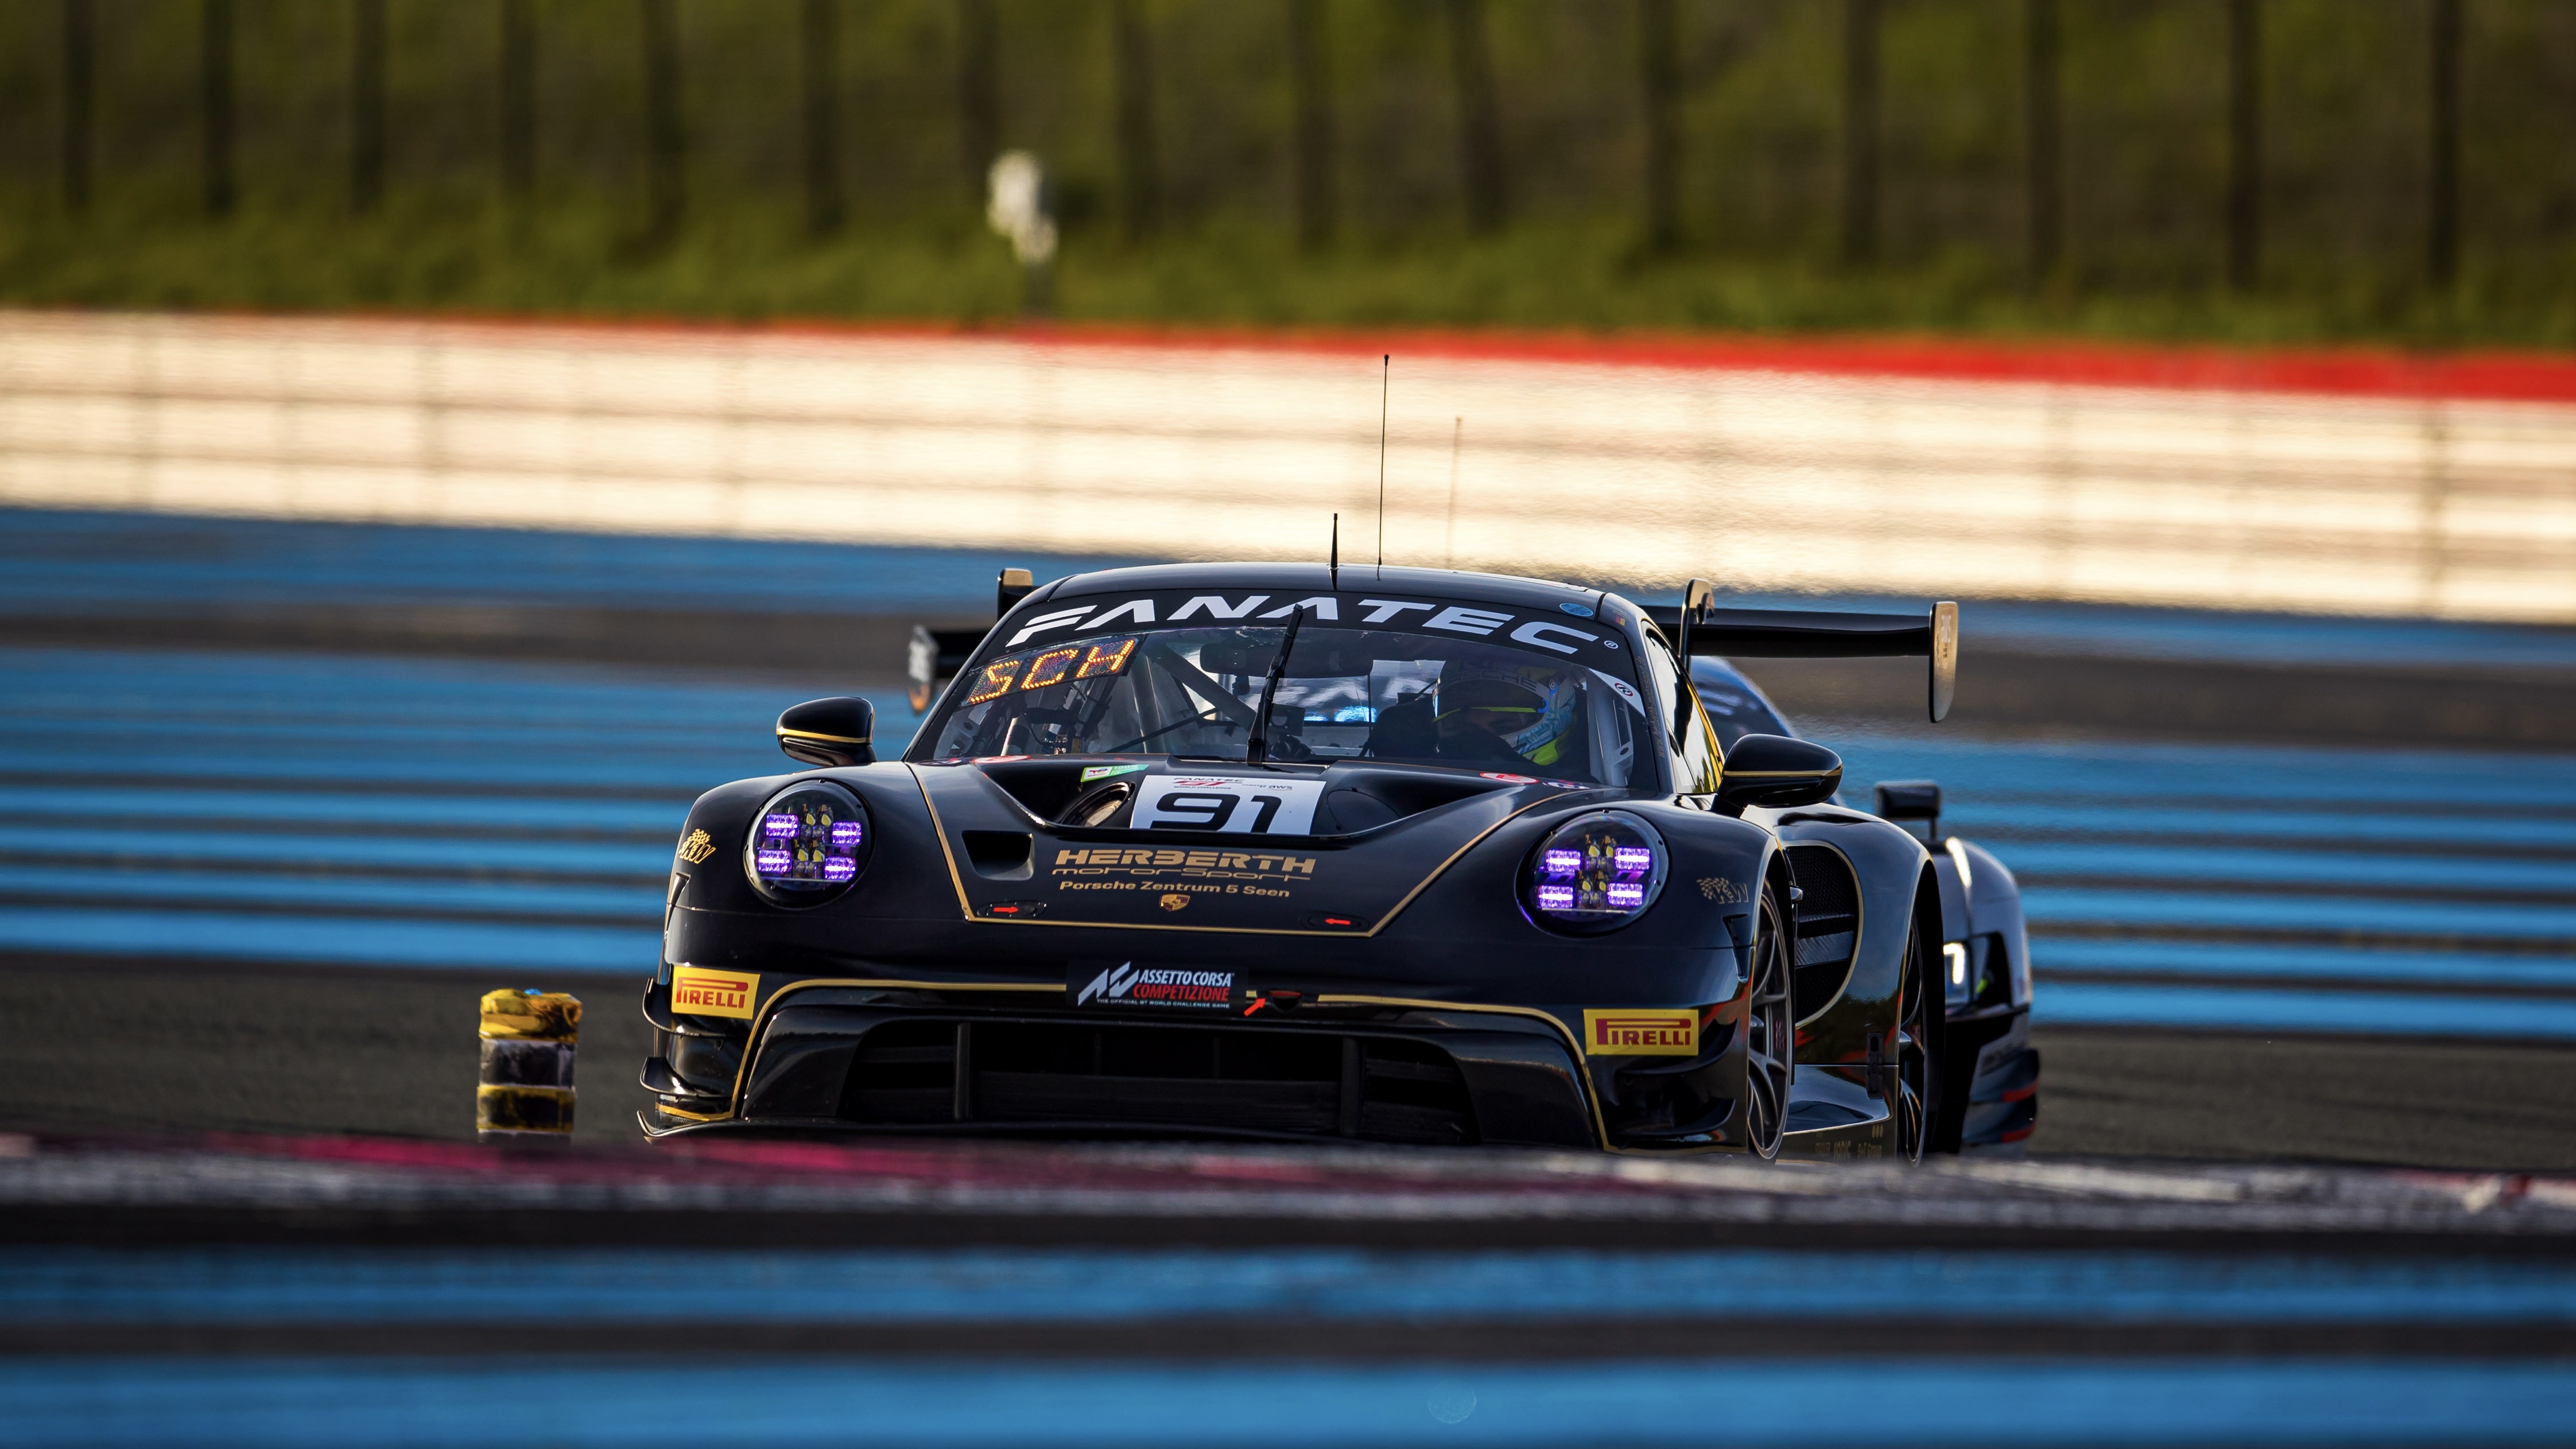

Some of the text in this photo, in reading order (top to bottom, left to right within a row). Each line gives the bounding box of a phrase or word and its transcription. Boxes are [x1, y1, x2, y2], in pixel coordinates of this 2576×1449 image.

[1006, 596, 1599, 654] FANATEC
[968, 638, 1135, 705] SCH
[1150, 792, 1282, 834] 91
[1055, 849, 1317, 874] HERBERTH
[1059, 881, 1290, 898] Porsche Zentrum 5 Seen
[1139, 969, 1232, 987] ASSETTO CORSA
[676, 977, 748, 1009] PIRELLI
[1133, 984, 1230, 1001] COMPETIZIONE
[1596, 1018, 1692, 1045] PIRELLI
